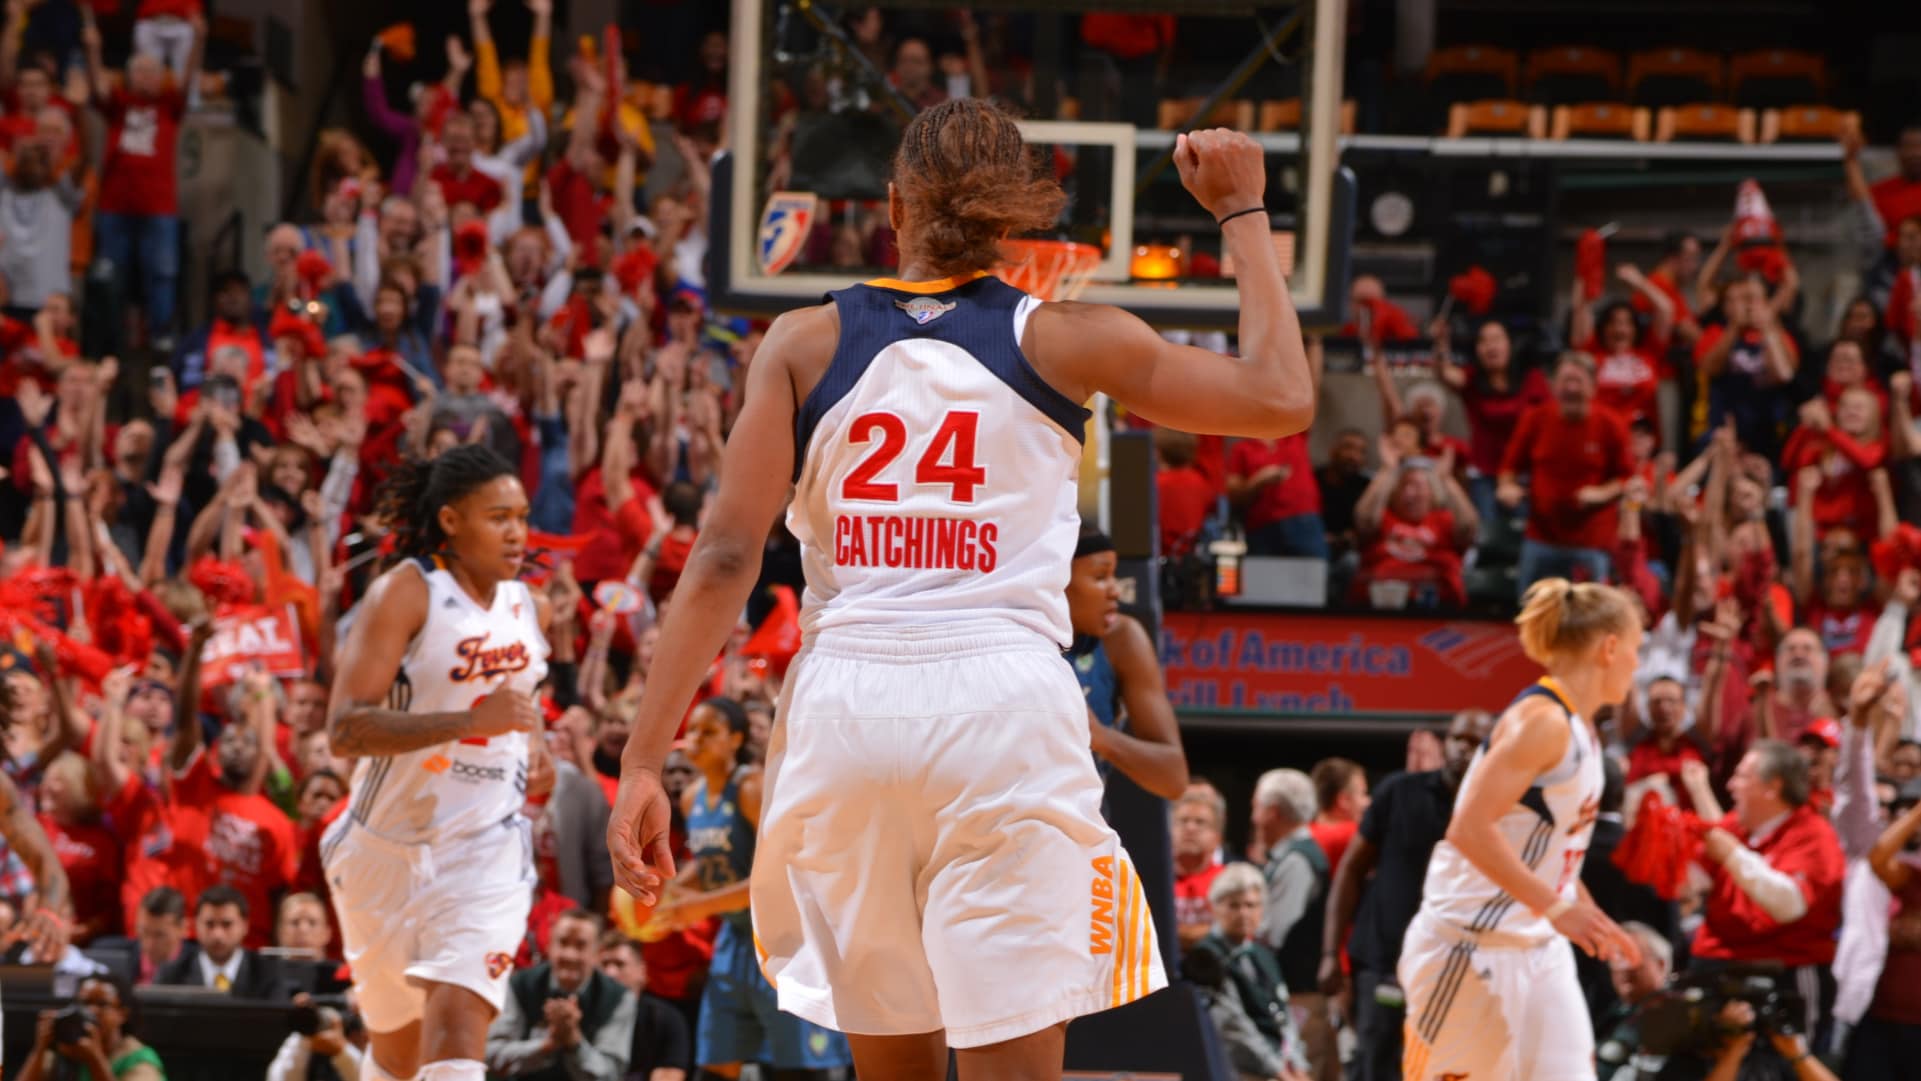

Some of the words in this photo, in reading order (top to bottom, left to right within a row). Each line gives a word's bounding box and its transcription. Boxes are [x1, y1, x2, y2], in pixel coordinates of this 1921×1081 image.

[841, 410, 986, 503] 24
[835, 515, 998, 574] CATCHINGS
[450, 630, 531, 684] Fever
[1191, 628, 1236, 669] of
[1238, 630, 1413, 675] America
[452, 760, 506, 781] boost
[1089, 855, 1114, 955] WNBA
